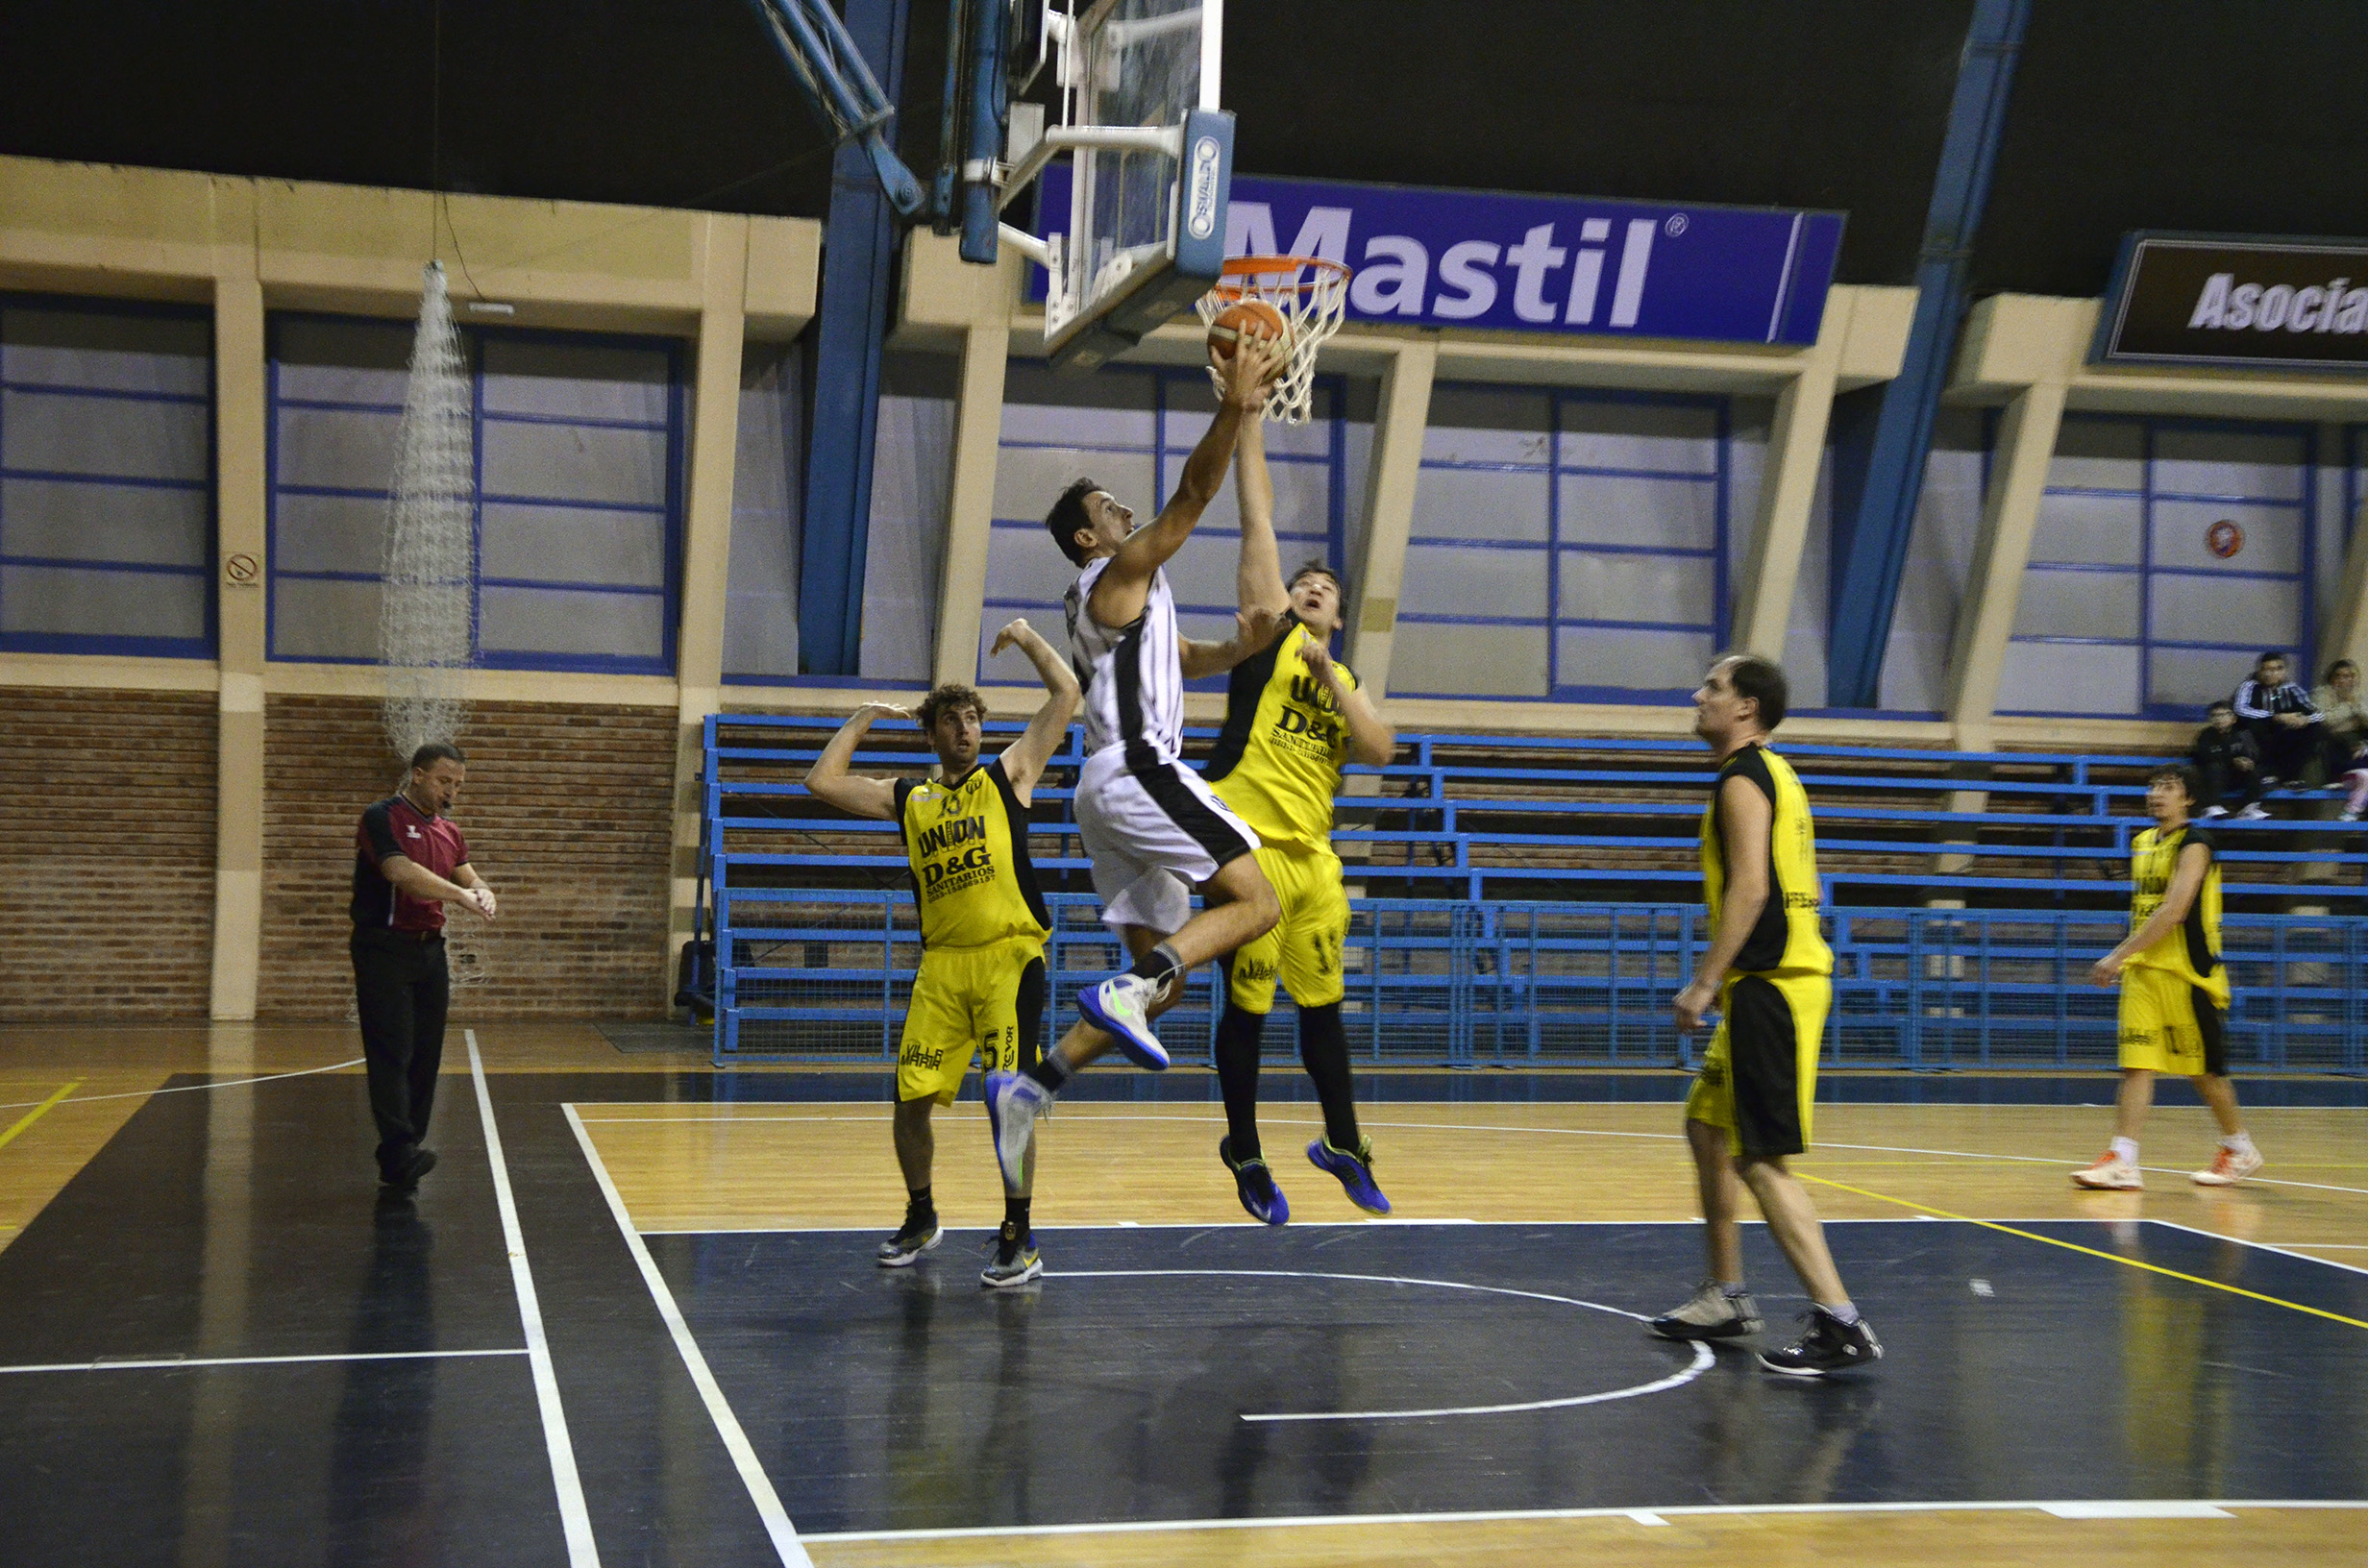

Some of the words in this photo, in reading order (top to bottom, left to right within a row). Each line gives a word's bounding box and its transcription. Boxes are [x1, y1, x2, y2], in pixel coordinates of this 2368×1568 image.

[1223, 200, 1658, 329] Mastil
[918, 816, 985, 858] UNION
[922, 846, 991, 888] D&G
[926, 866, 995, 897] SANITARIOS
